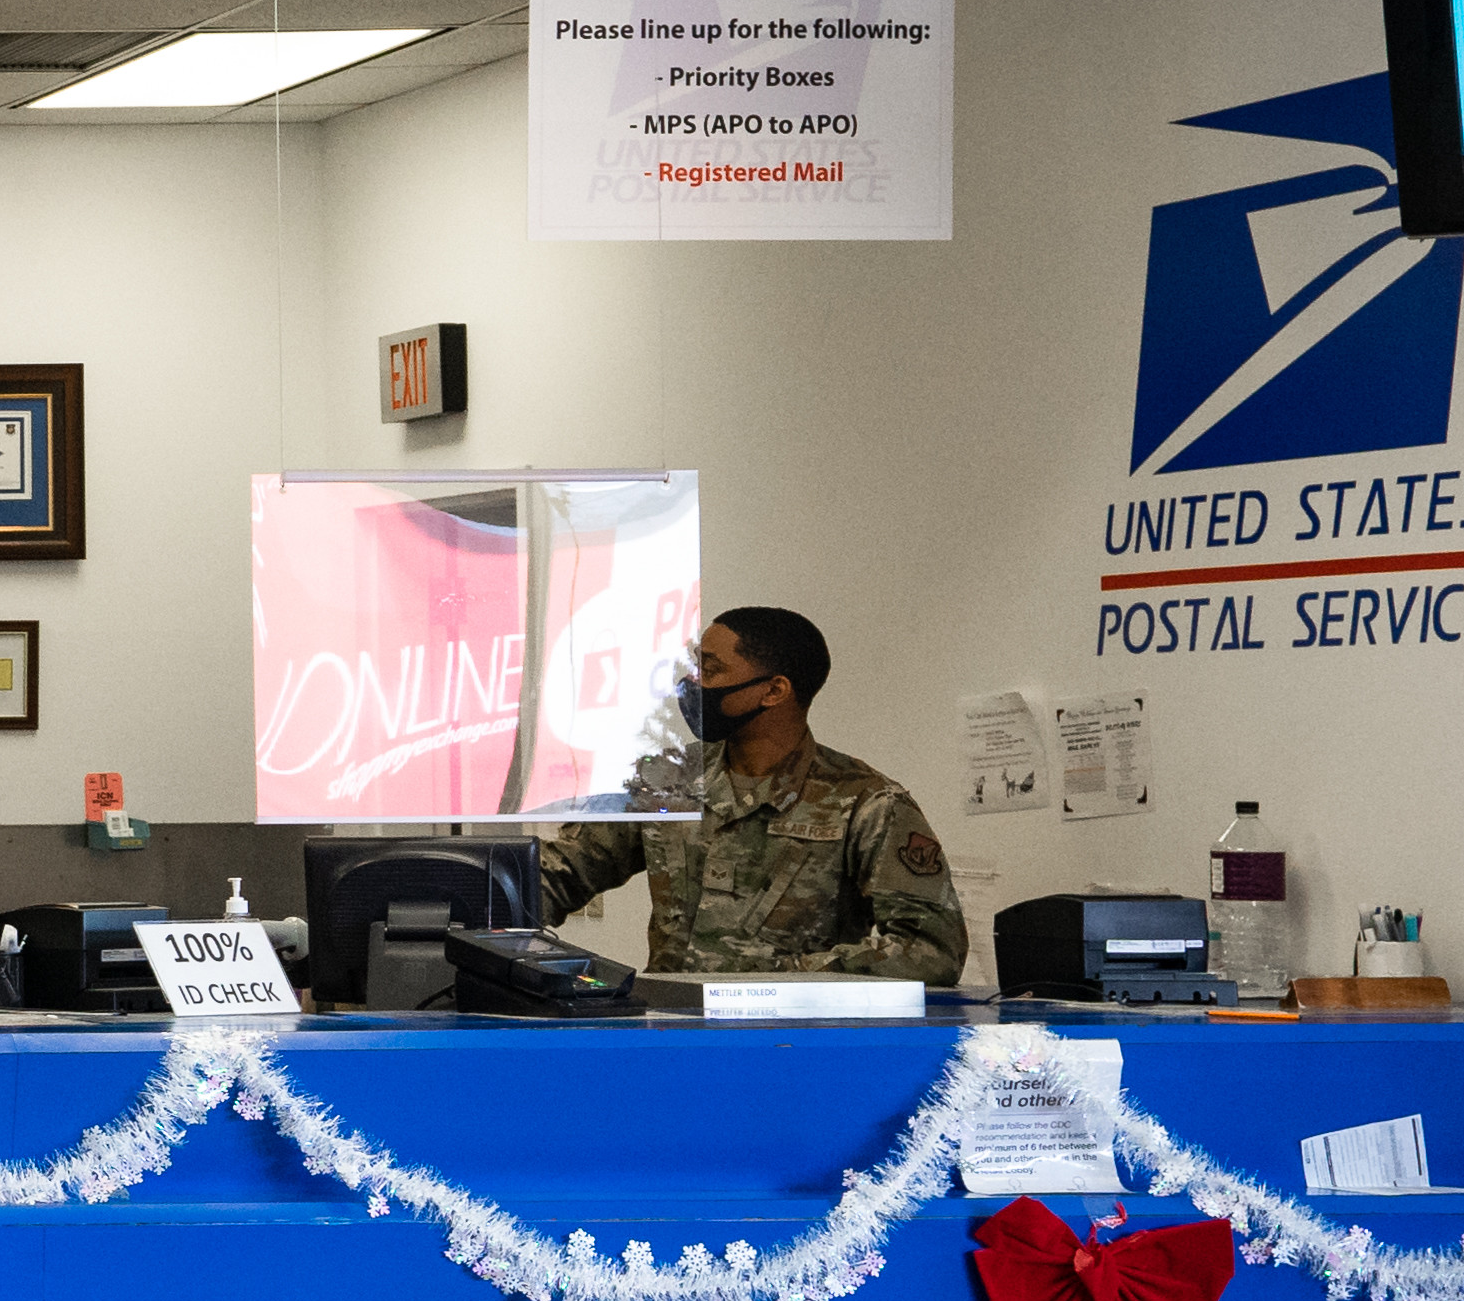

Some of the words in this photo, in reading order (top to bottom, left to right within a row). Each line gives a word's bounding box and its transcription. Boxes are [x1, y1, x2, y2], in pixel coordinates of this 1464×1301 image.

[556, 19, 634, 40] Please
[640, 18, 685, 40] line
[691, 23, 723, 45] up
[727, 17, 763, 39] for
[767, 17, 808, 39] the
[812, 17, 931, 46] following:
[670, 66, 760, 92] Priority
[765, 66, 835, 87] Boxes
[644, 114, 697, 135] MPS
[703, 114, 763, 137] (APO
[768, 116, 794, 135] to
[799, 113, 858, 138] APO)
[659, 161, 787, 188] Registered
[793, 160, 844, 183] Mail
[389, 337, 428, 411] EXIT
[1105, 490, 1269, 555] UNITED
[1295, 471, 1464, 541] STATE
[1097, 596, 1265, 656] POSTAL
[164, 931, 254, 963] 100%
[177, 984, 204, 1005] ID
[207, 981, 281, 1005] CHECK
[708, 988, 743, 998] METTLER
[746, 987, 778, 997] TOLEDO
